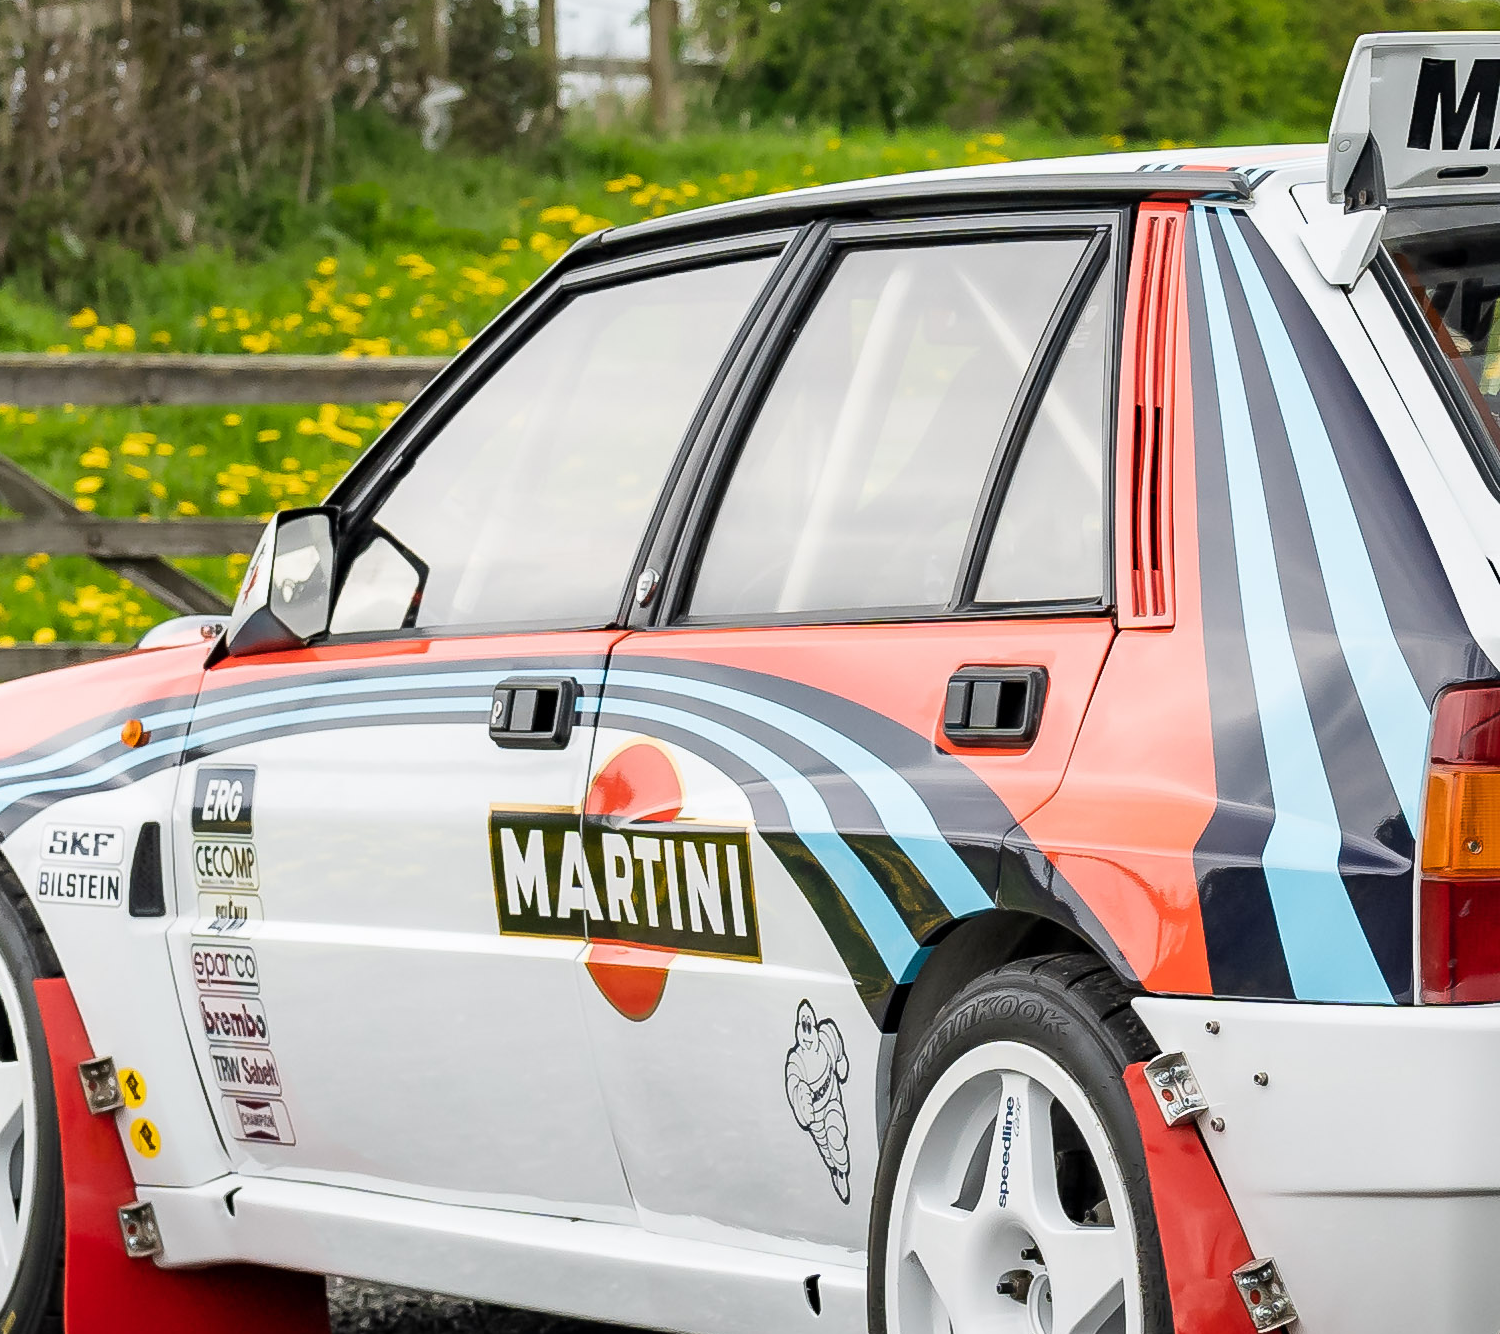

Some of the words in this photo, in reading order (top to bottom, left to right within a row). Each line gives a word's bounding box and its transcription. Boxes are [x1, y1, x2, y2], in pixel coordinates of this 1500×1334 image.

[202, 779, 243, 822] ERG
[48, 829, 114, 857] SKF
[196, 845, 254, 878] CECOMP
[38, 871, 120, 901] BILSTEIN
[500, 827, 748, 937] MARTINI
[194, 952, 256, 987] sparco
[201, 1001, 266, 1038] brembo
[213, 1055, 241, 1083] TRW
[241, 1056, 279, 1086] Sabelt
[999, 1097, 1014, 1208] speedline
